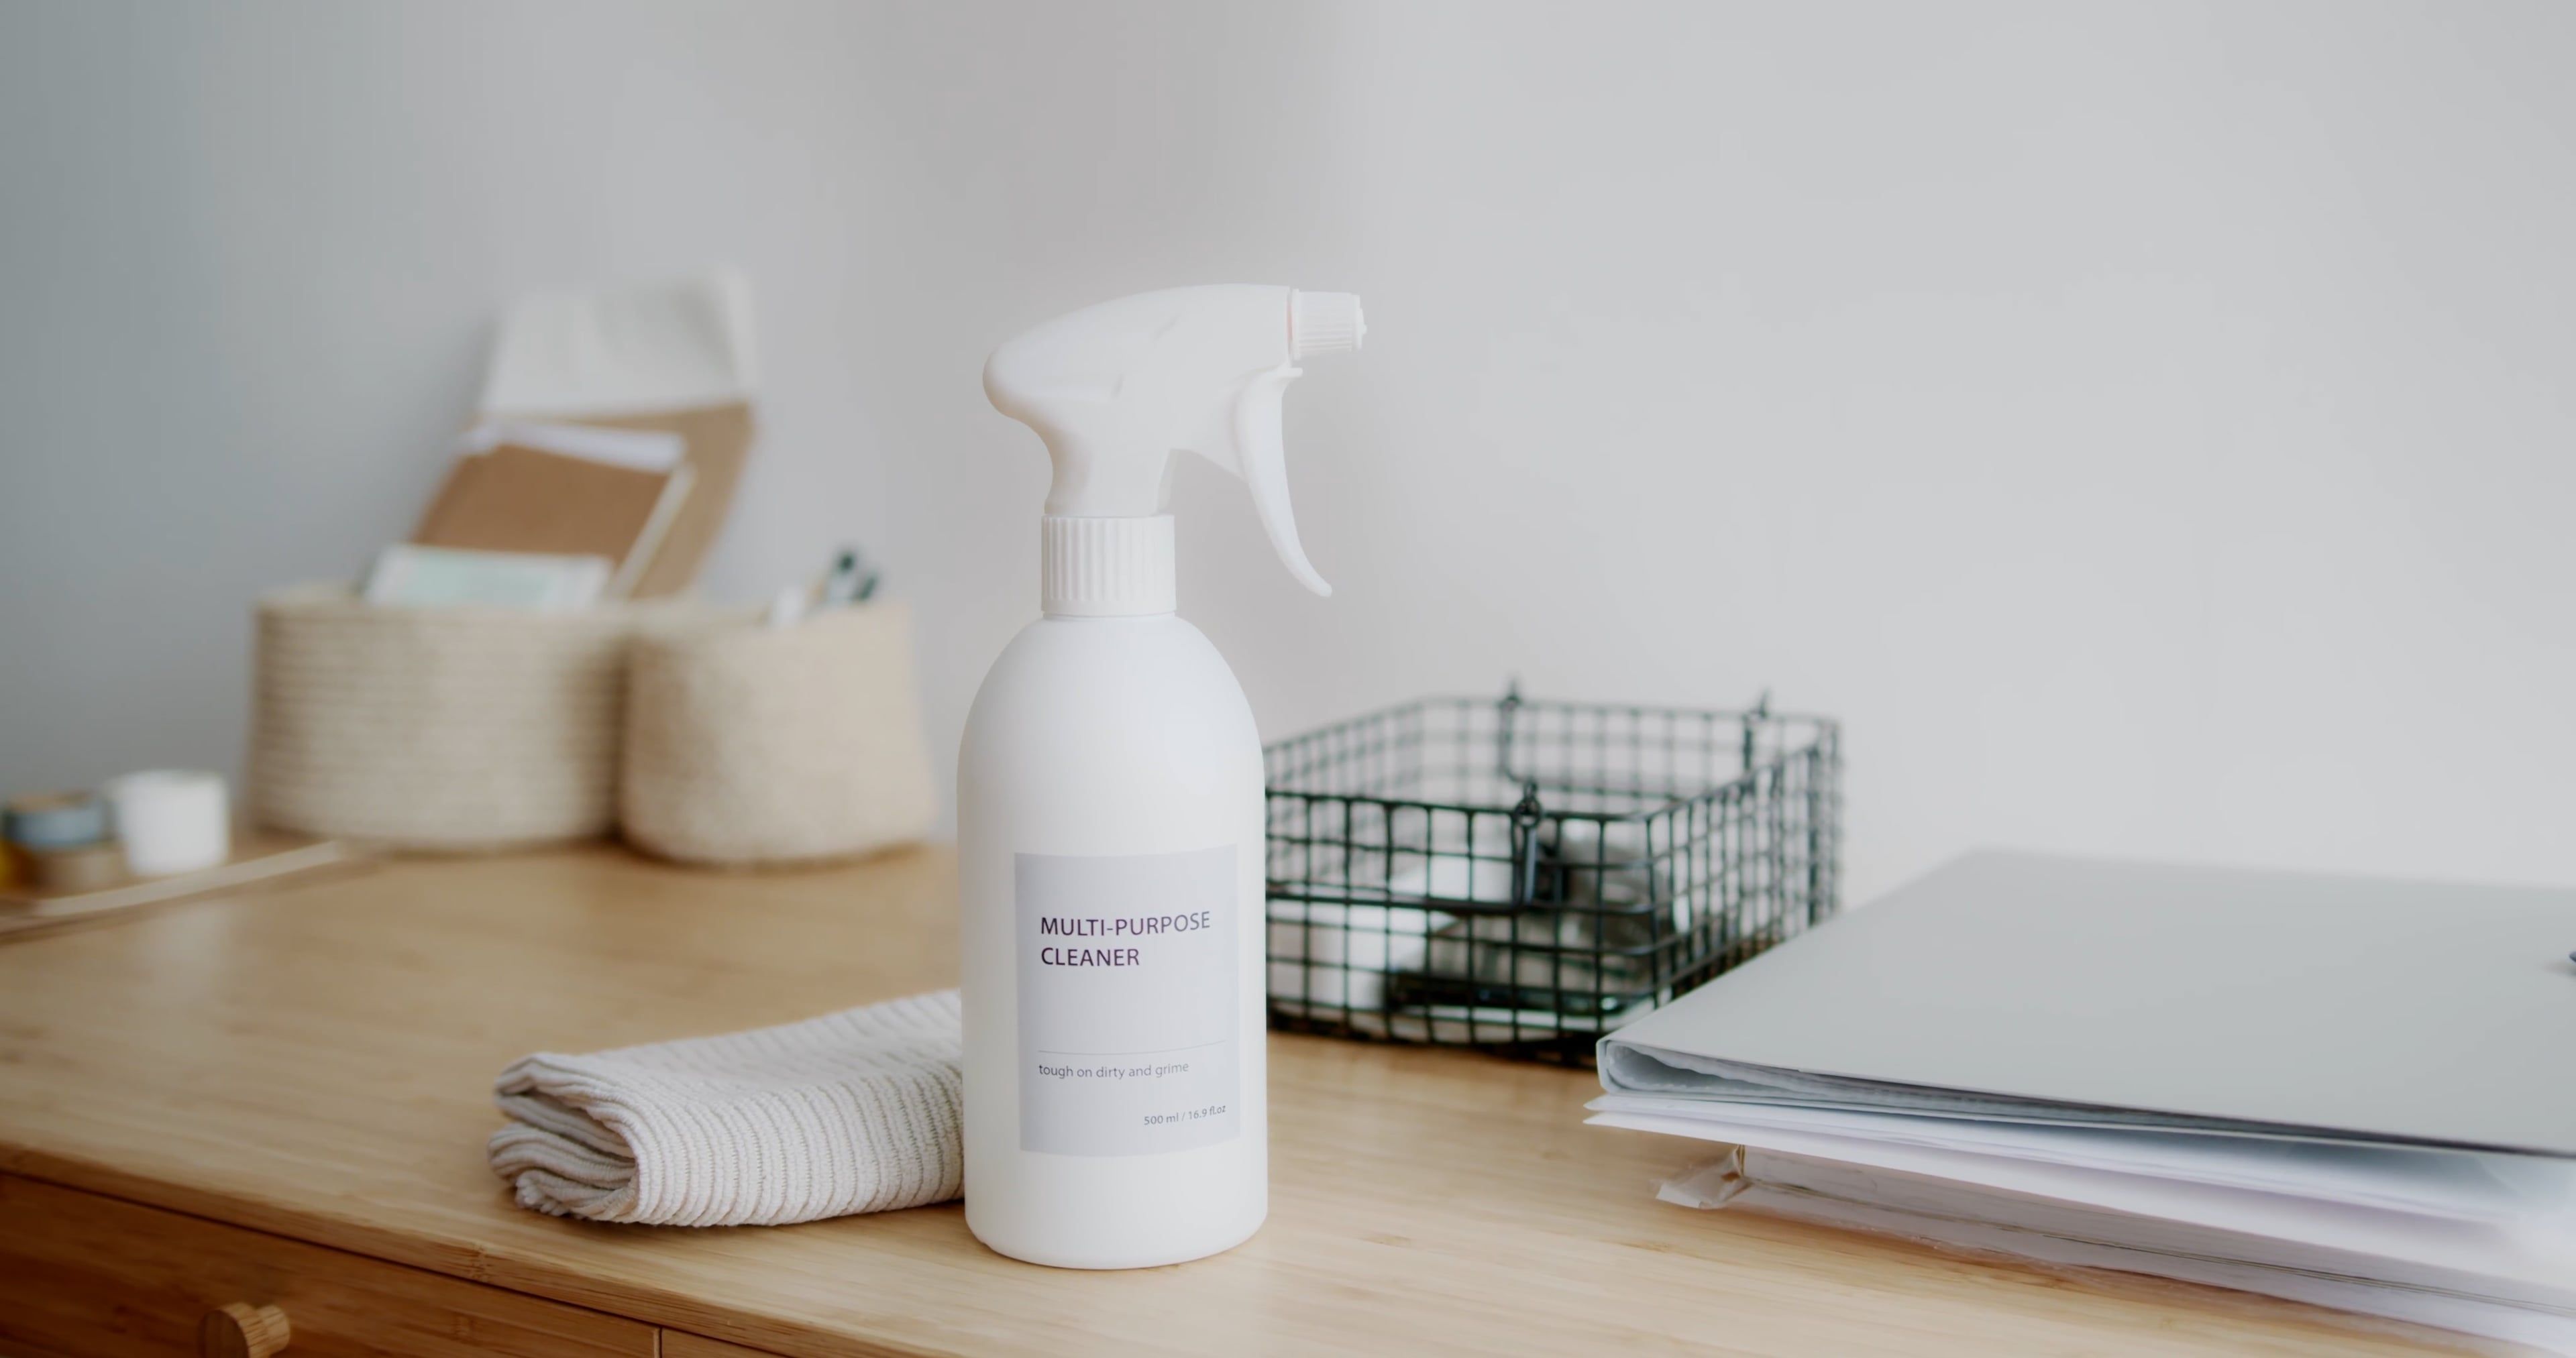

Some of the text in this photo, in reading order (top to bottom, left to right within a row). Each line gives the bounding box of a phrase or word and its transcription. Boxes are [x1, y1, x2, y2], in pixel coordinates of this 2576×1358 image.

[1040, 911, 1211, 936] MULTI-PURPOSE
[1040, 947, 1140, 966] CLEANER
[1038, 1062, 1189, 1080] tough on dirty and grime
[1144, 1115, 1164, 1125] 500
[1166, 1112, 1179, 1123] ml
[1188, 1108, 1208, 1120] 16.9
